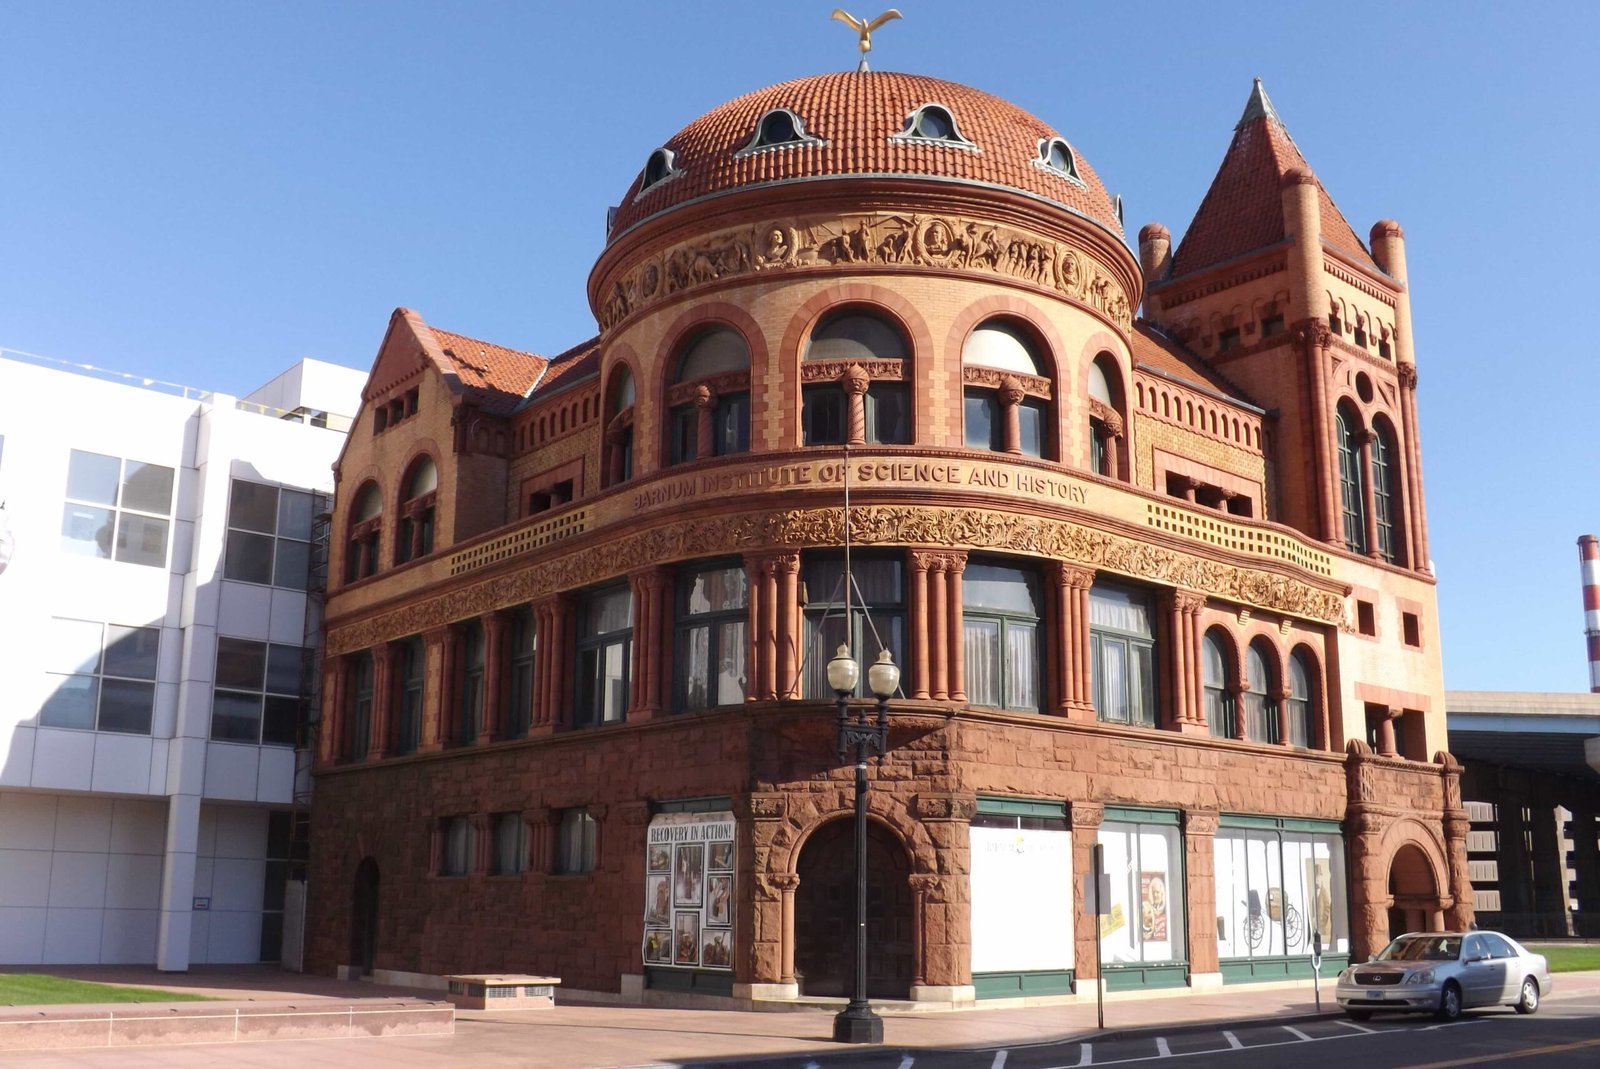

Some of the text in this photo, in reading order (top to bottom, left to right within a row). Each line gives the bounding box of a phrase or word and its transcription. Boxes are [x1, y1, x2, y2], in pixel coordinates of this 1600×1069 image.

[633, 463, 1089, 510] BARNUM INSTITUTE OF SCIENCE AND HISTORY
[651, 824, 731, 842] RECOVERY IN ACTION!
